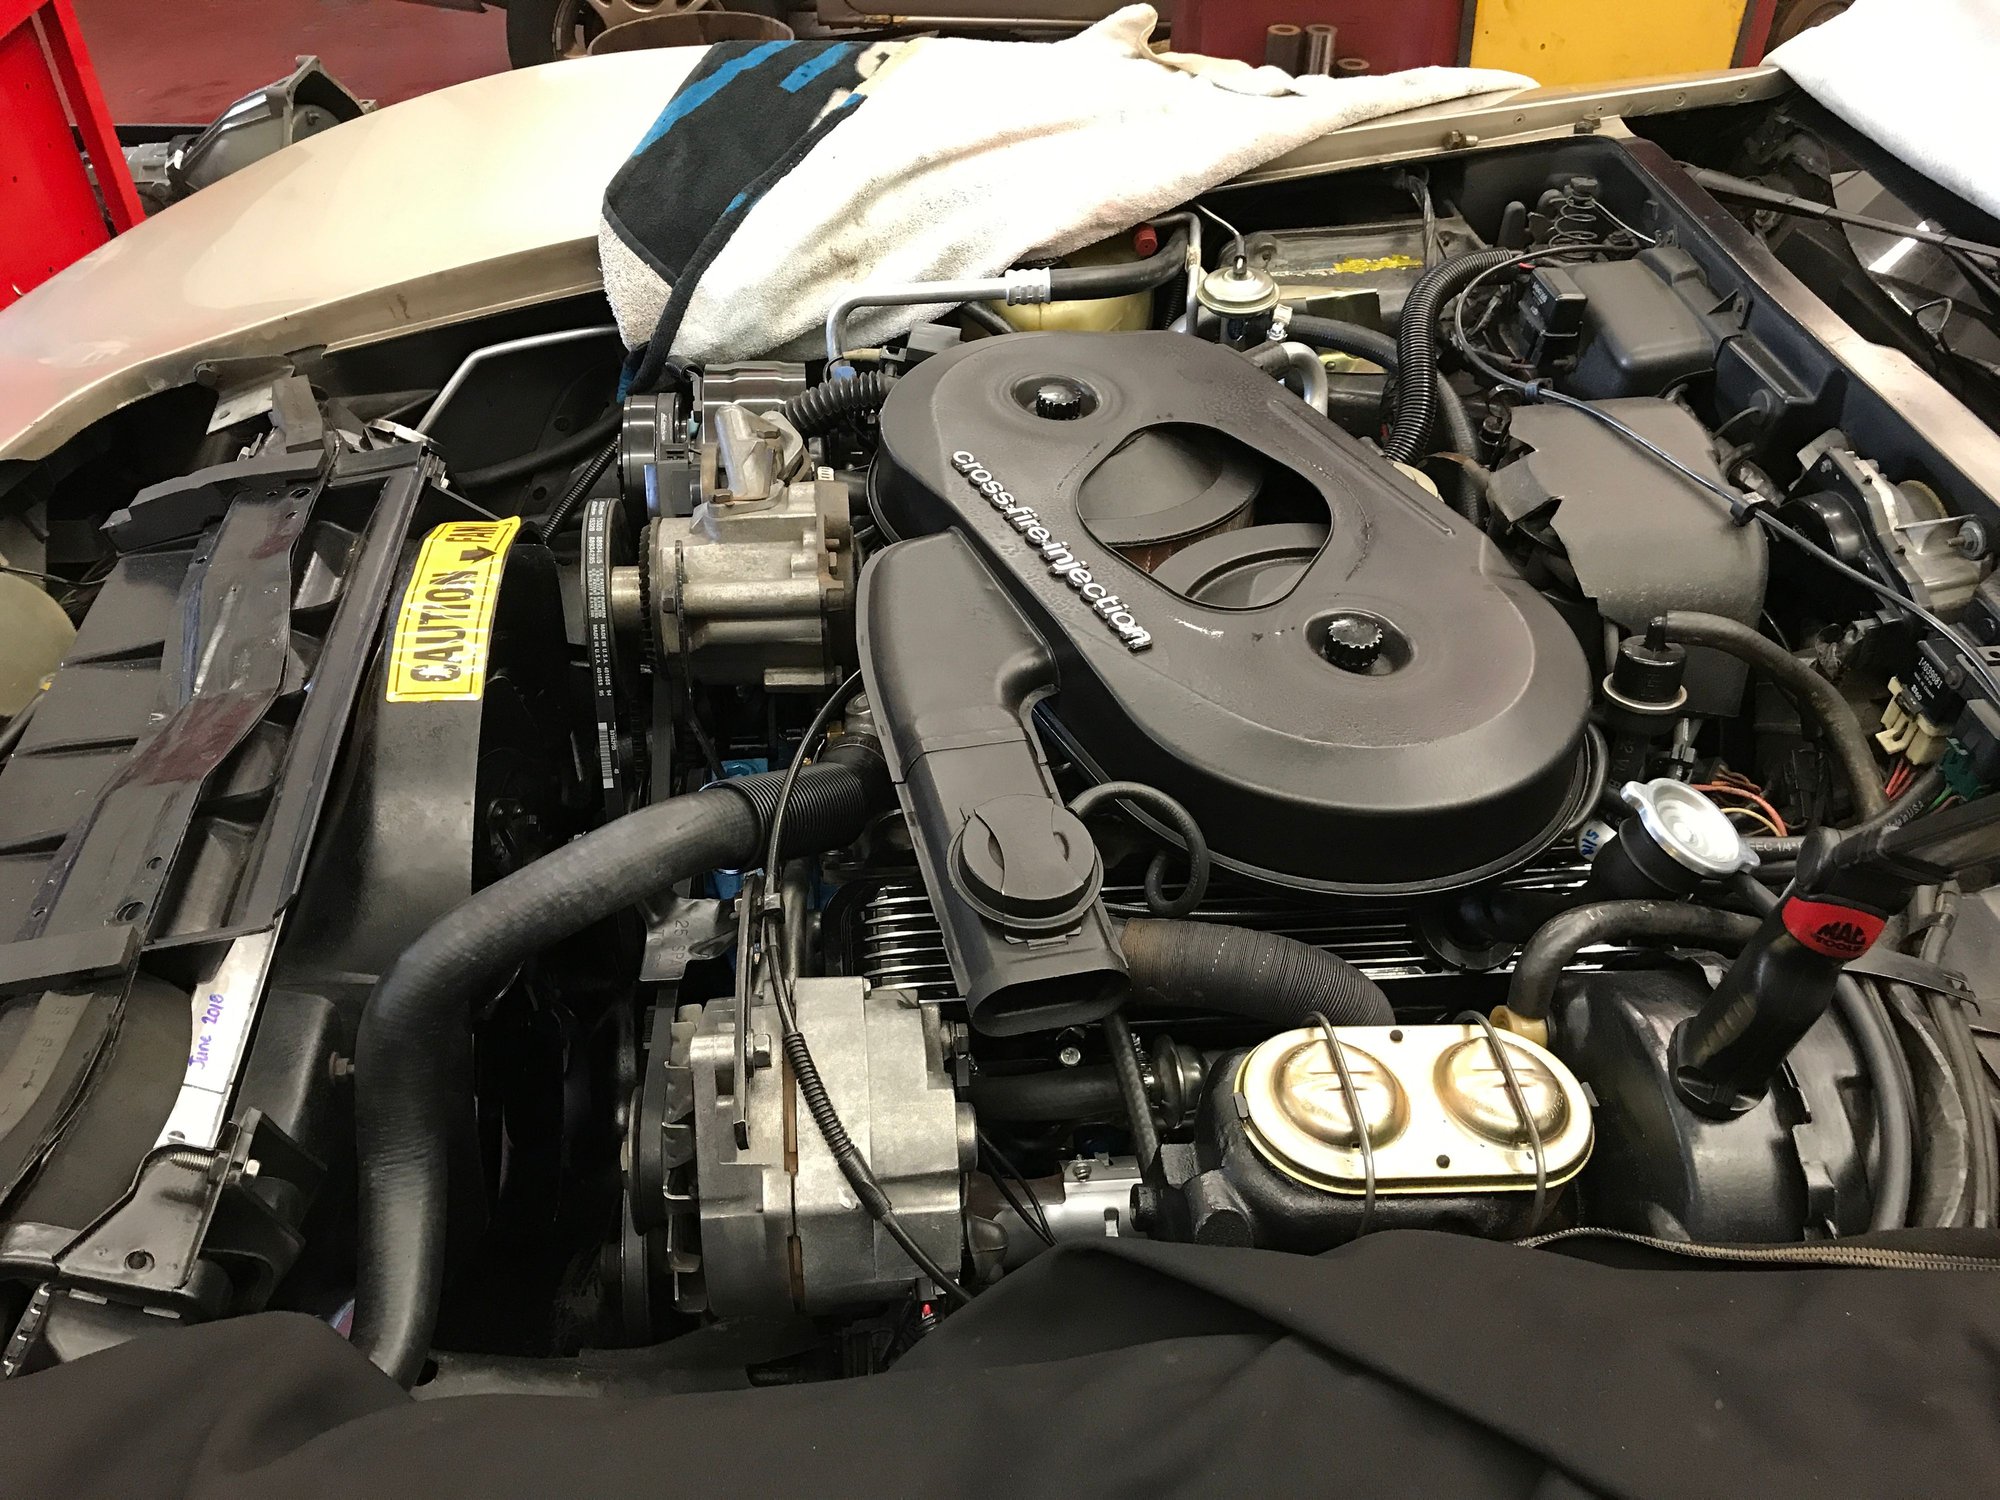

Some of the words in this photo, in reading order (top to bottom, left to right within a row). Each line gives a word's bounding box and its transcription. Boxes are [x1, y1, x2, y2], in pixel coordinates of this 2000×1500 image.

[410, 570, 479, 682] CAUTION
[445, 526, 499, 543] FAN
[673, 919, 690, 936] 25
[1816, 920, 1867, 946] MAC
[188, 1035, 212, 1070] June
[201, 991, 224, 1025] 2018
